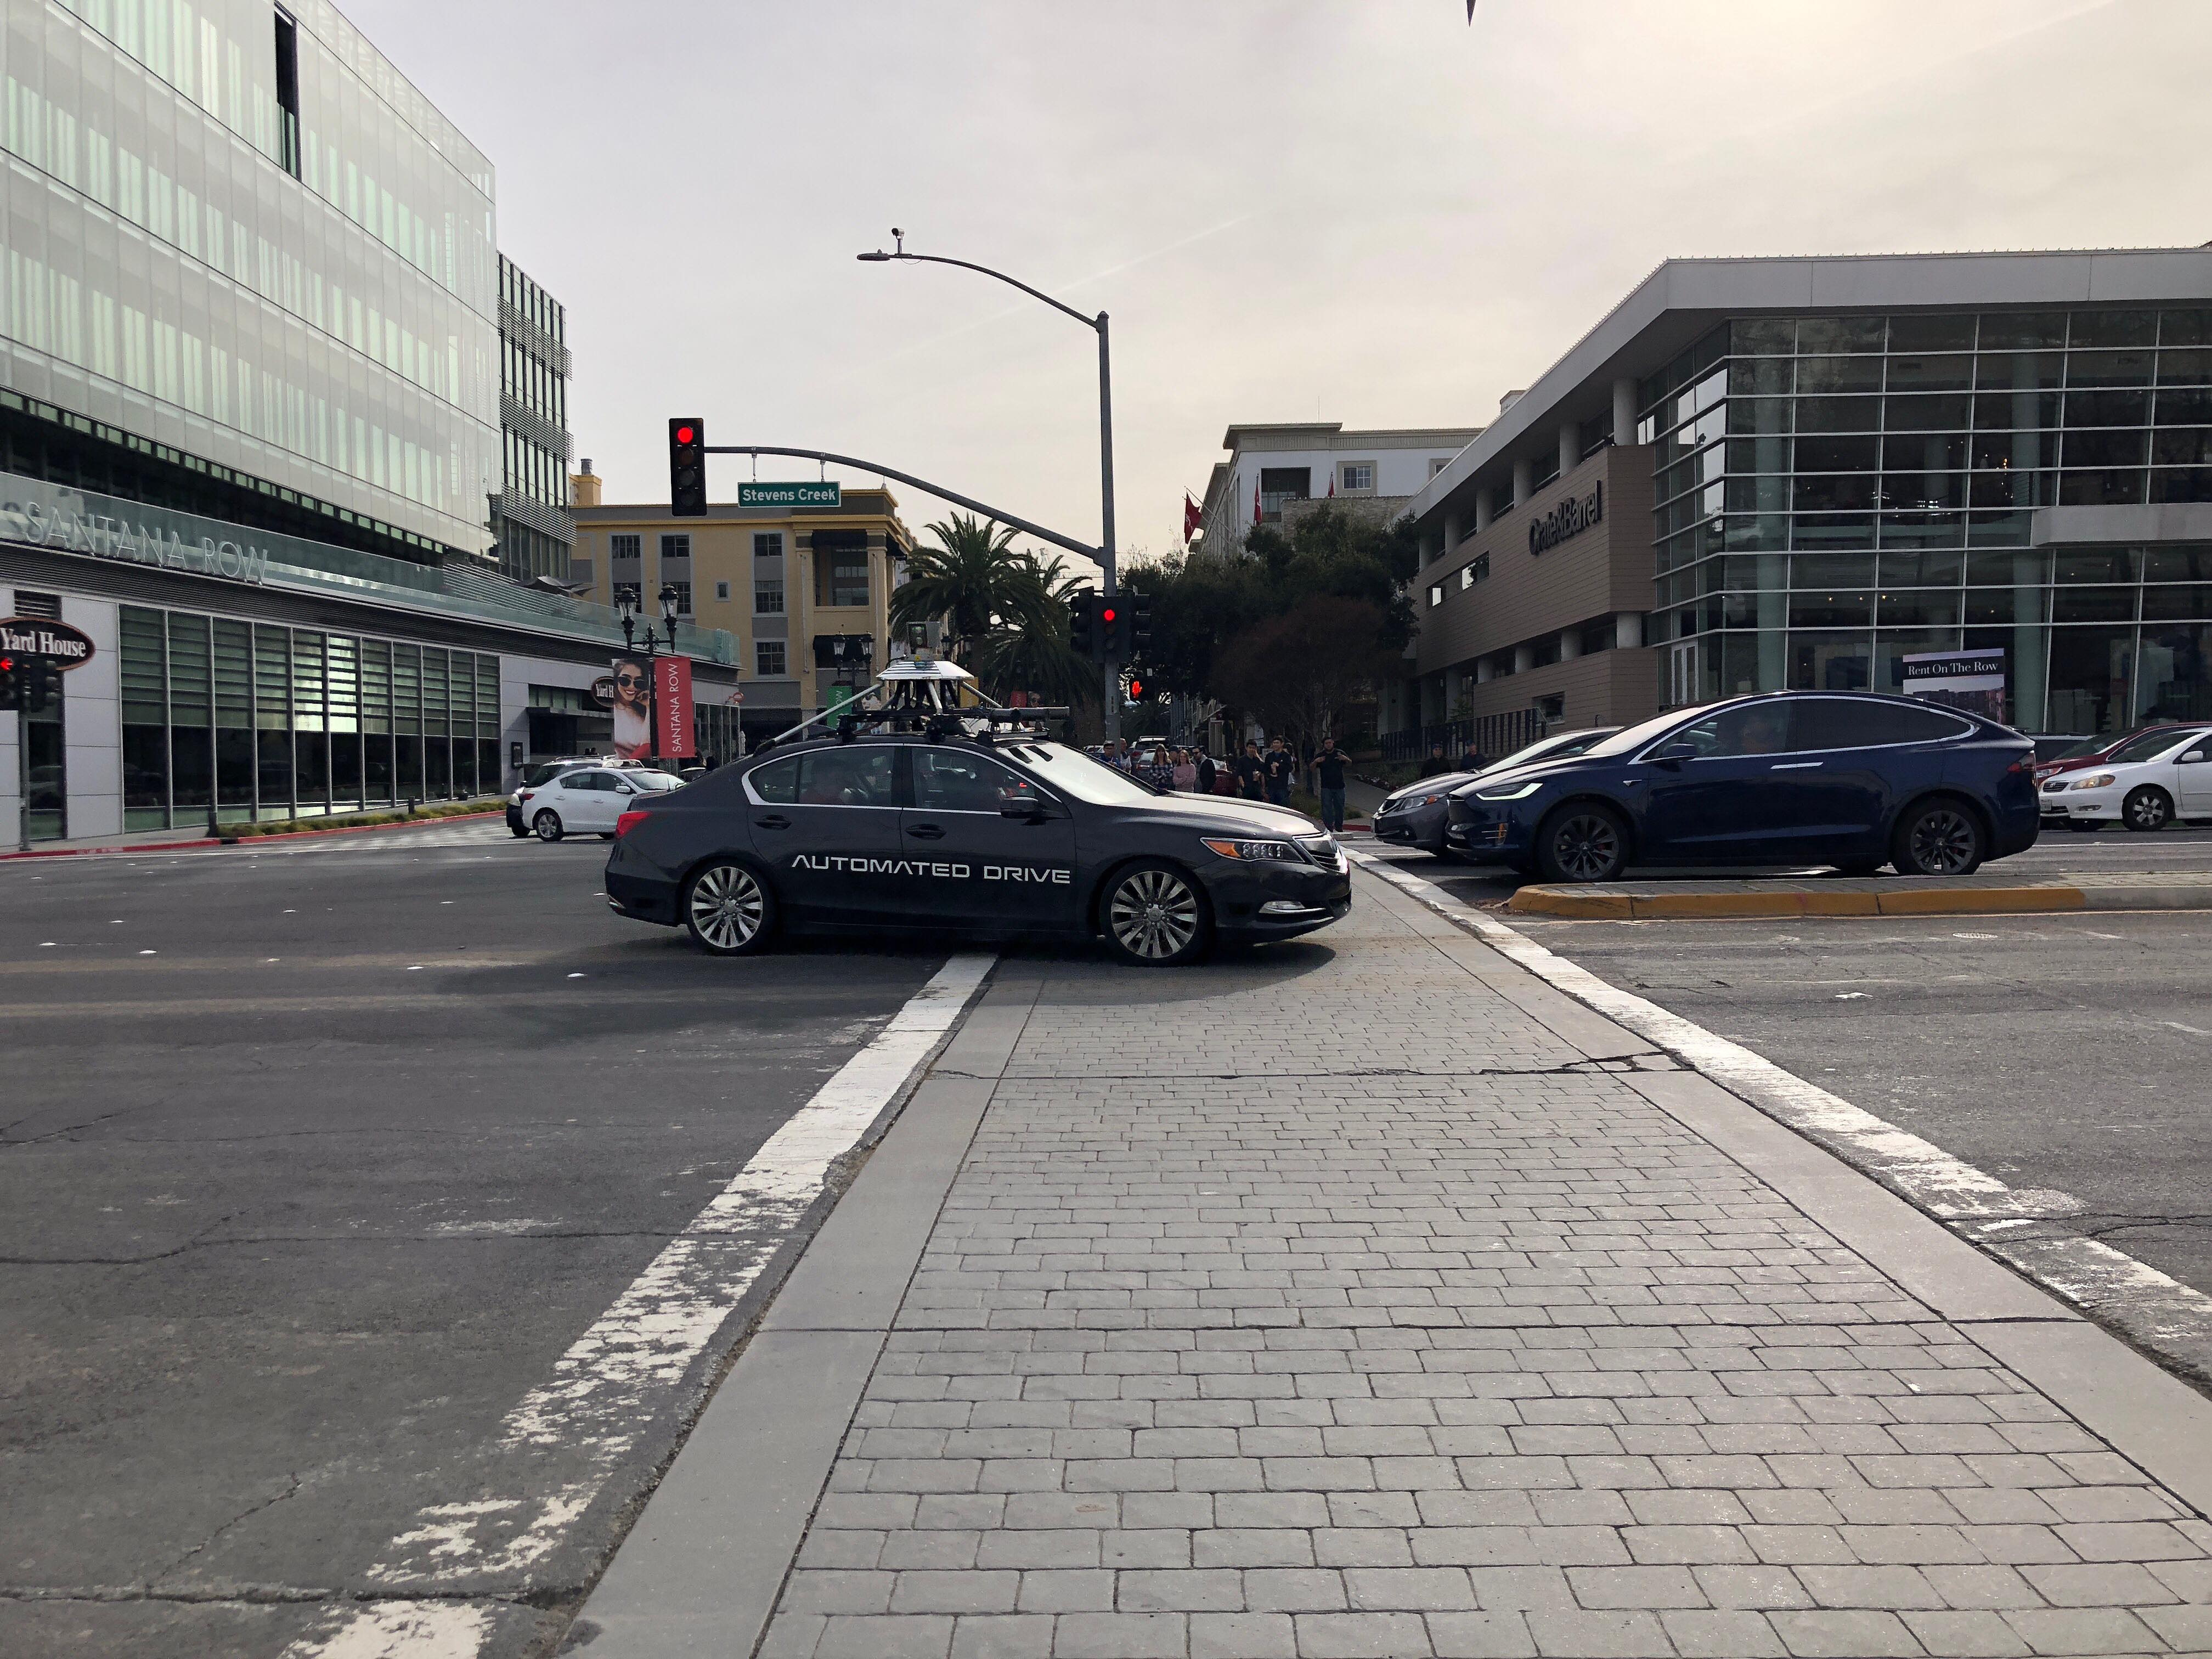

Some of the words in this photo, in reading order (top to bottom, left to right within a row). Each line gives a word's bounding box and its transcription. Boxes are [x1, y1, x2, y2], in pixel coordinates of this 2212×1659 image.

[743, 489, 795, 501] Stevens
[798, 488, 836, 500] Creek
[1529, 480, 1602, 556] Crate&Barrel
[26, 501, 188, 569] SANTANA
[202, 536, 268, 586] ROW
[0, 627, 37, 652] Yard
[38, 631, 87, 658] House
[668, 663, 679, 693] ROW
[1908, 665, 1930, 675] Rent
[1932, 664, 1948, 674] On
[1950, 662, 1972, 673] The
[1974, 661, 1999, 672] Row
[670, 696, 682, 752] SANTANA
[792, 855, 970, 878] AUTOMATED
[984, 866, 1070, 884] DRIVE
